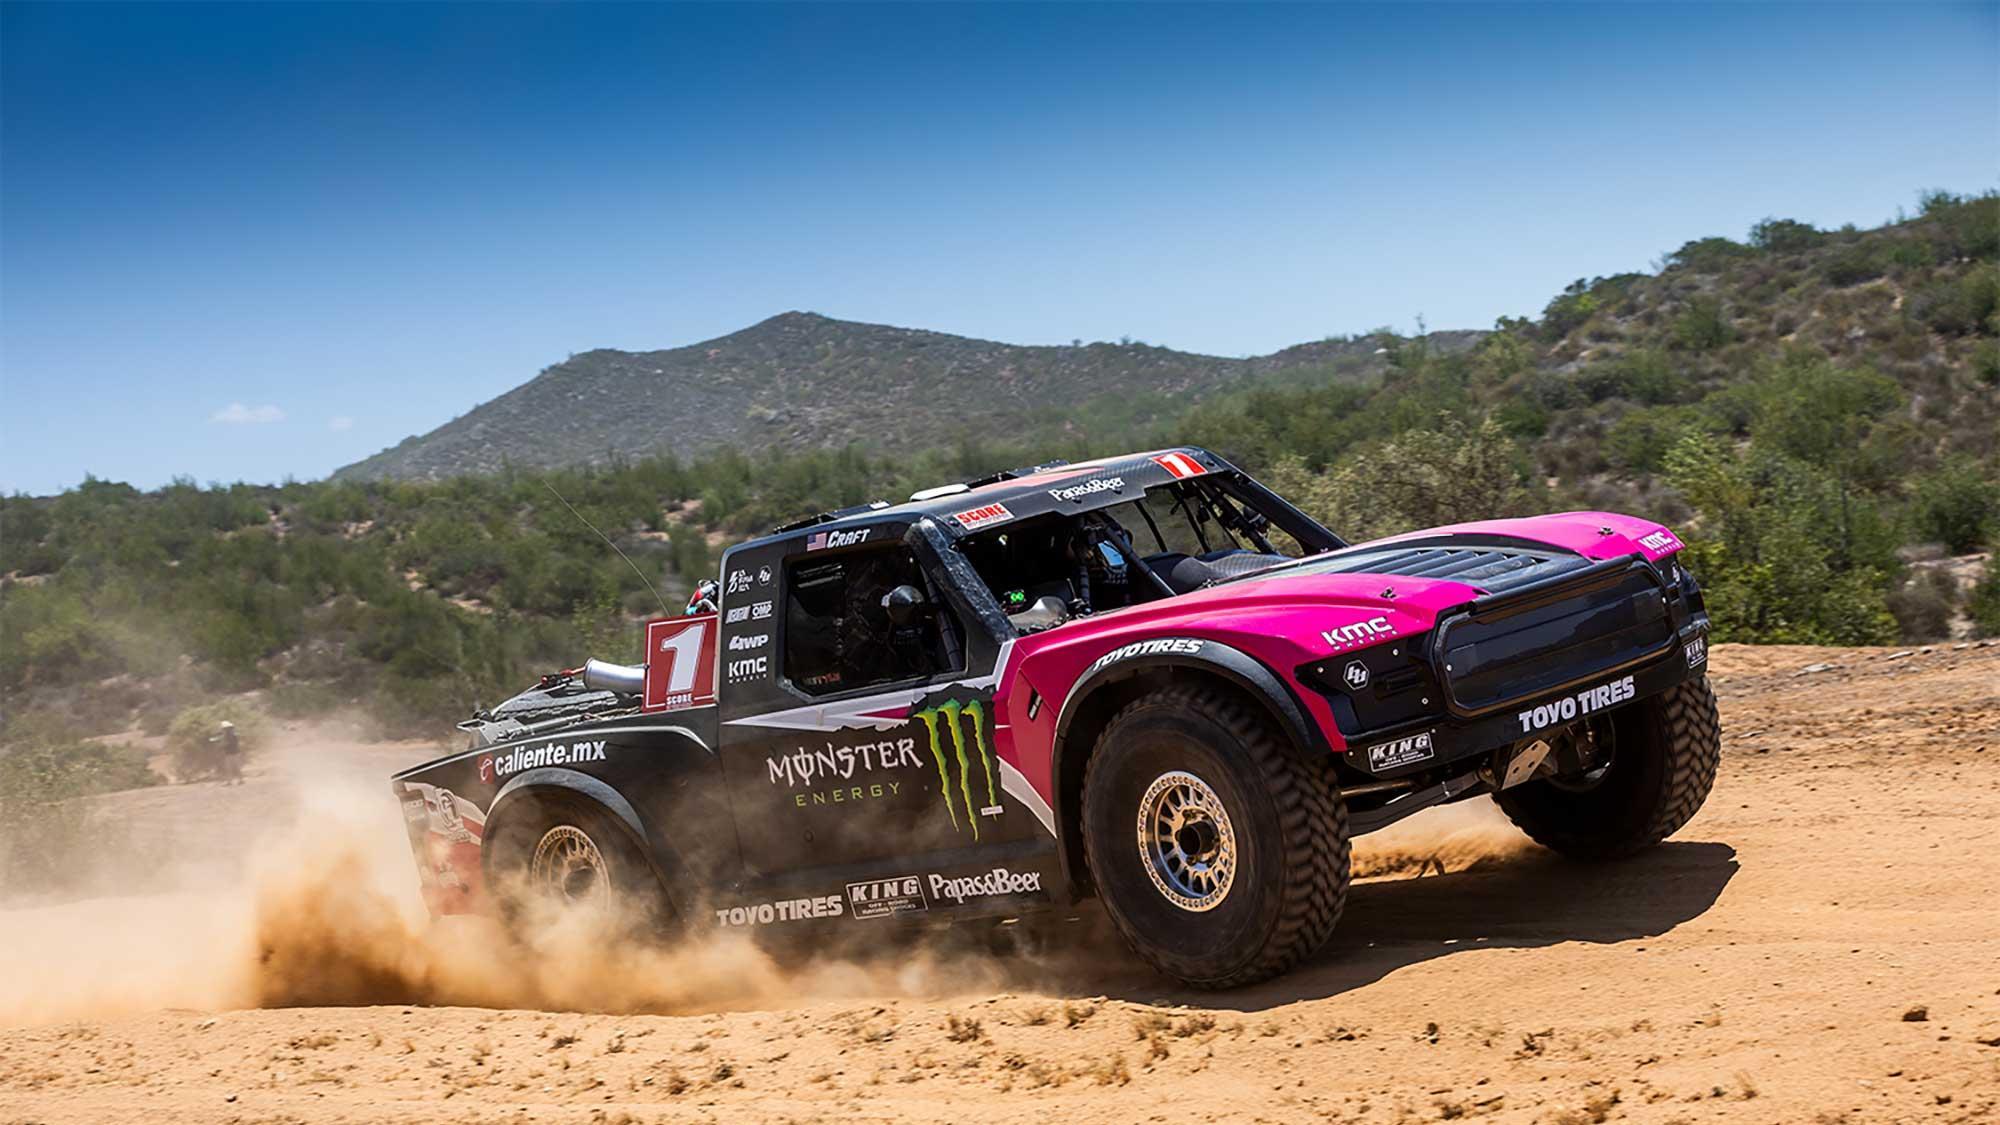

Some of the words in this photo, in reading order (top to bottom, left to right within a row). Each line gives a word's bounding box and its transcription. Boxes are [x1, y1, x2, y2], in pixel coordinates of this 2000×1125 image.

[1159, 453, 1194, 478] 1
[957, 504, 1006, 524] SCORE
[1638, 531, 1673, 551] KMC
[1321, 616, 1393, 646] KMC
[661, 622, 707, 694] 1
[728, 656, 767, 677] KMC
[1092, 641, 1143, 672] TOYO
[1139, 639, 1204, 655] TIRES
[666, 693, 693, 705] SCORE
[1518, 697, 1577, 733] TOYO
[1577, 675, 1636, 715] TIRES
[494, 740, 607, 776] caliente.mx
[1372, 736, 1429, 761] KING
[766, 737, 924, 788] MONSTER
[795, 782, 900, 807] ENERGY
[852, 879, 918, 902] KING
[928, 868, 1041, 904] Papas&Beer
[716, 903, 775, 927] TOYO
[775, 895, 843, 921] TIRES
